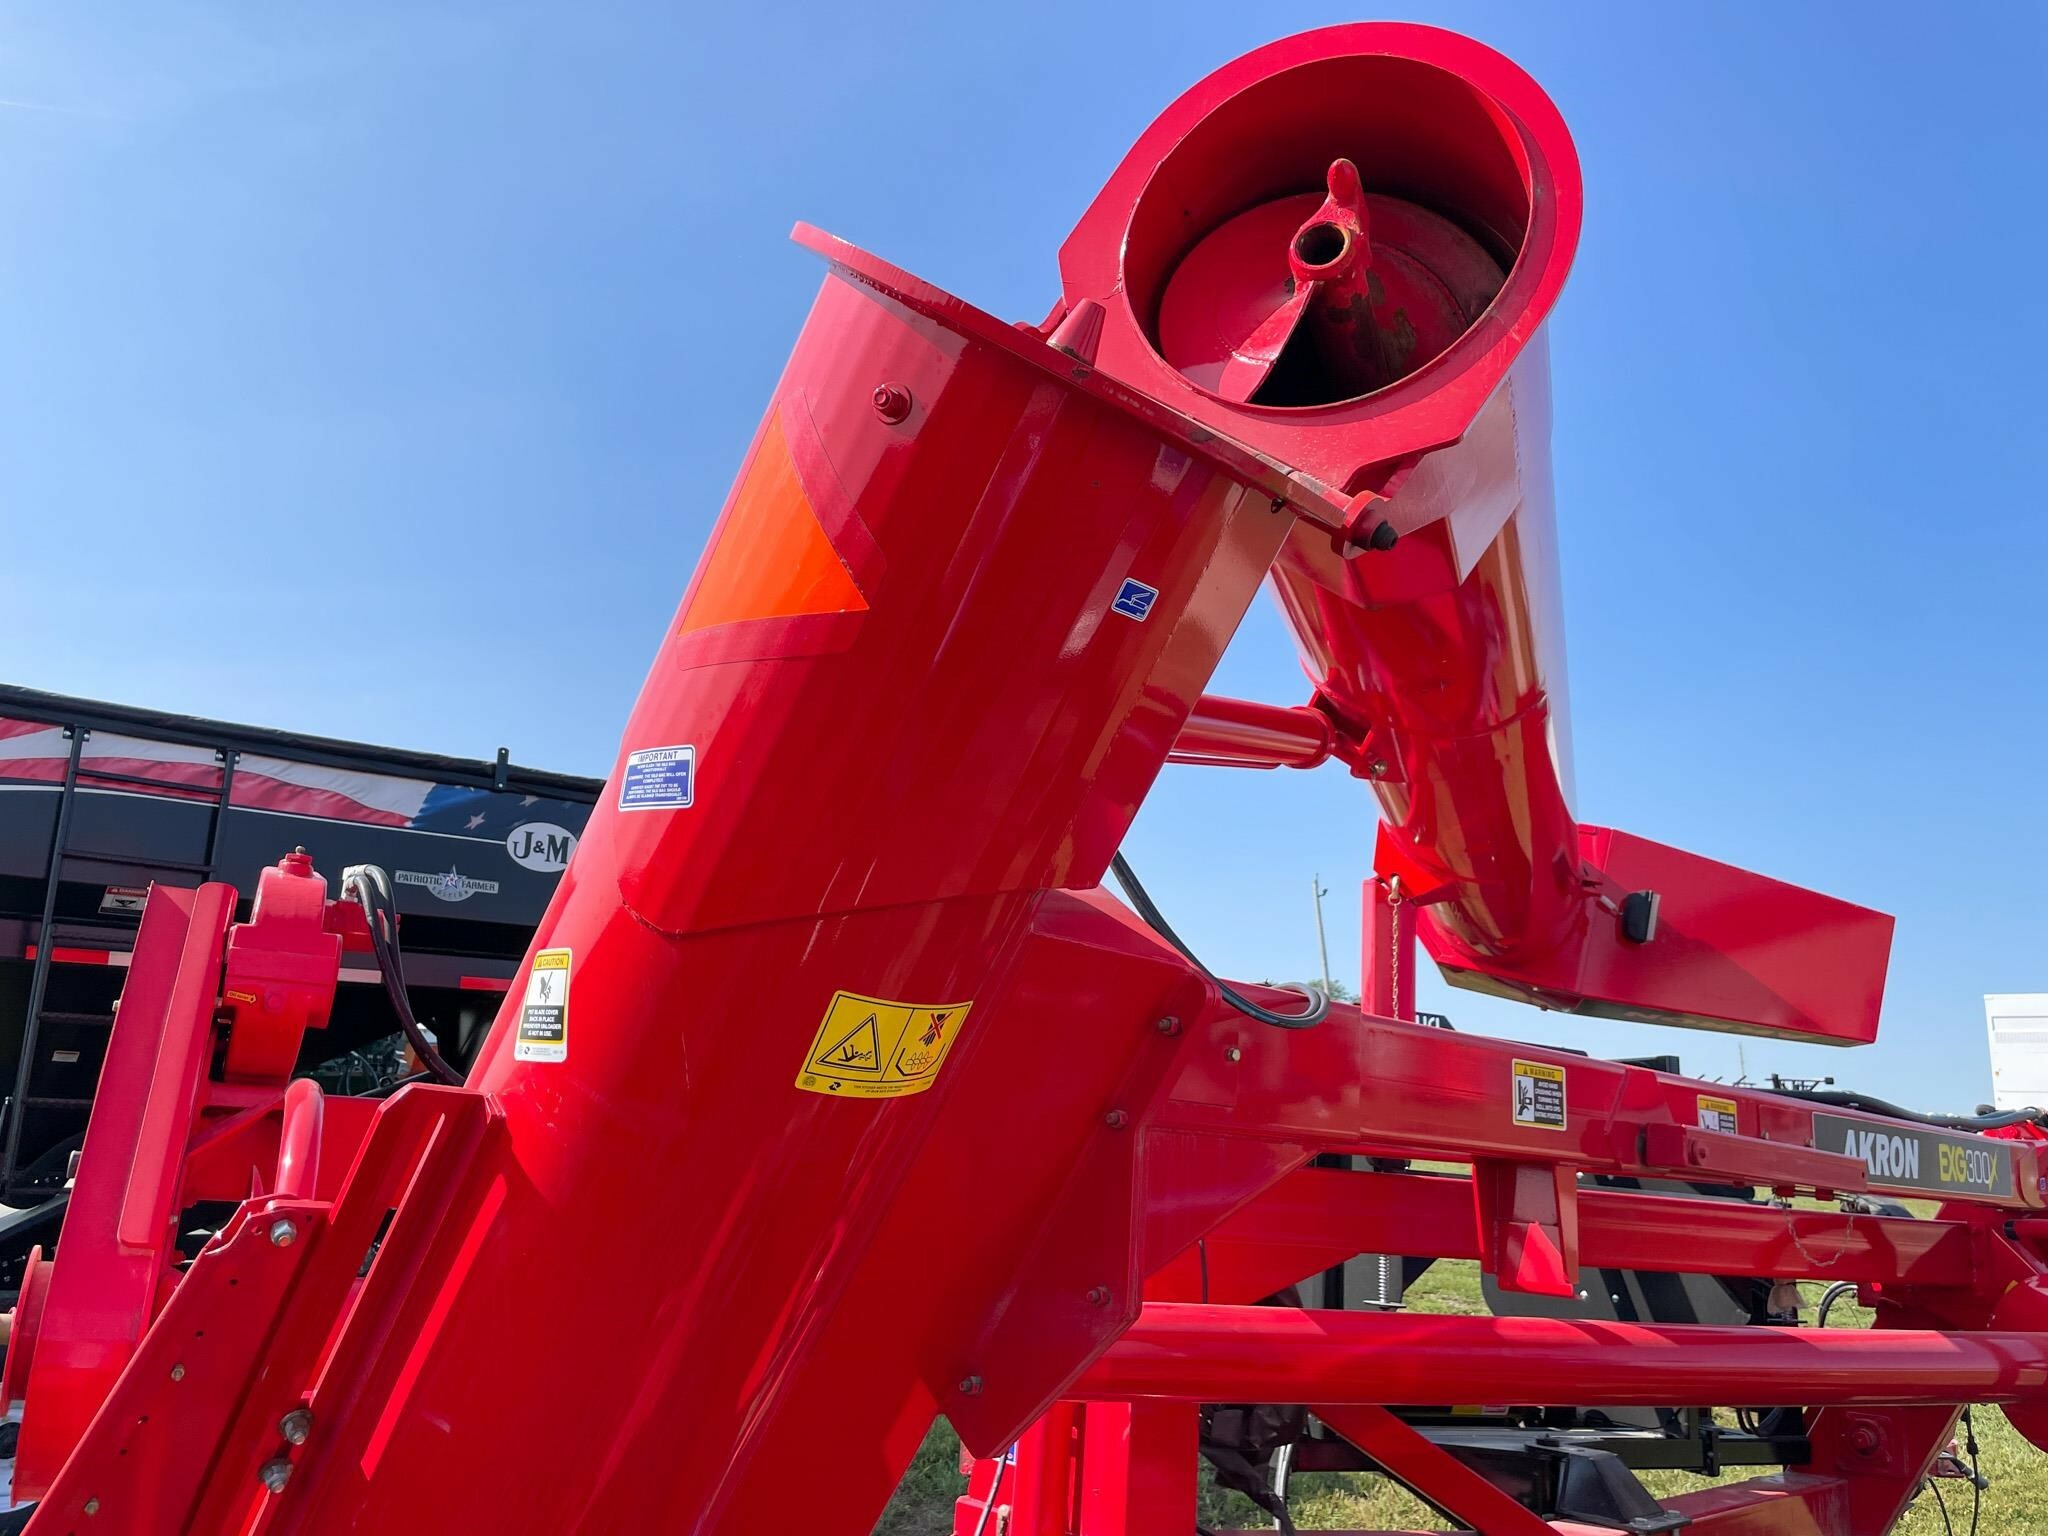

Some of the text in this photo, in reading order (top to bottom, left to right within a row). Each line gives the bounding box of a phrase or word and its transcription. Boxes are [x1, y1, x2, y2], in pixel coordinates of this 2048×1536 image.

[638, 751, 679, 762] IMPORTANT
[512, 831, 570, 864] J&M
[398, 873, 496, 892] PATRIOTIC FARMER
[542, 957, 564, 967] CAUTION
[1529, 1068, 1555, 1078] WARNING
[1844, 1129, 1919, 1179] AKRON
